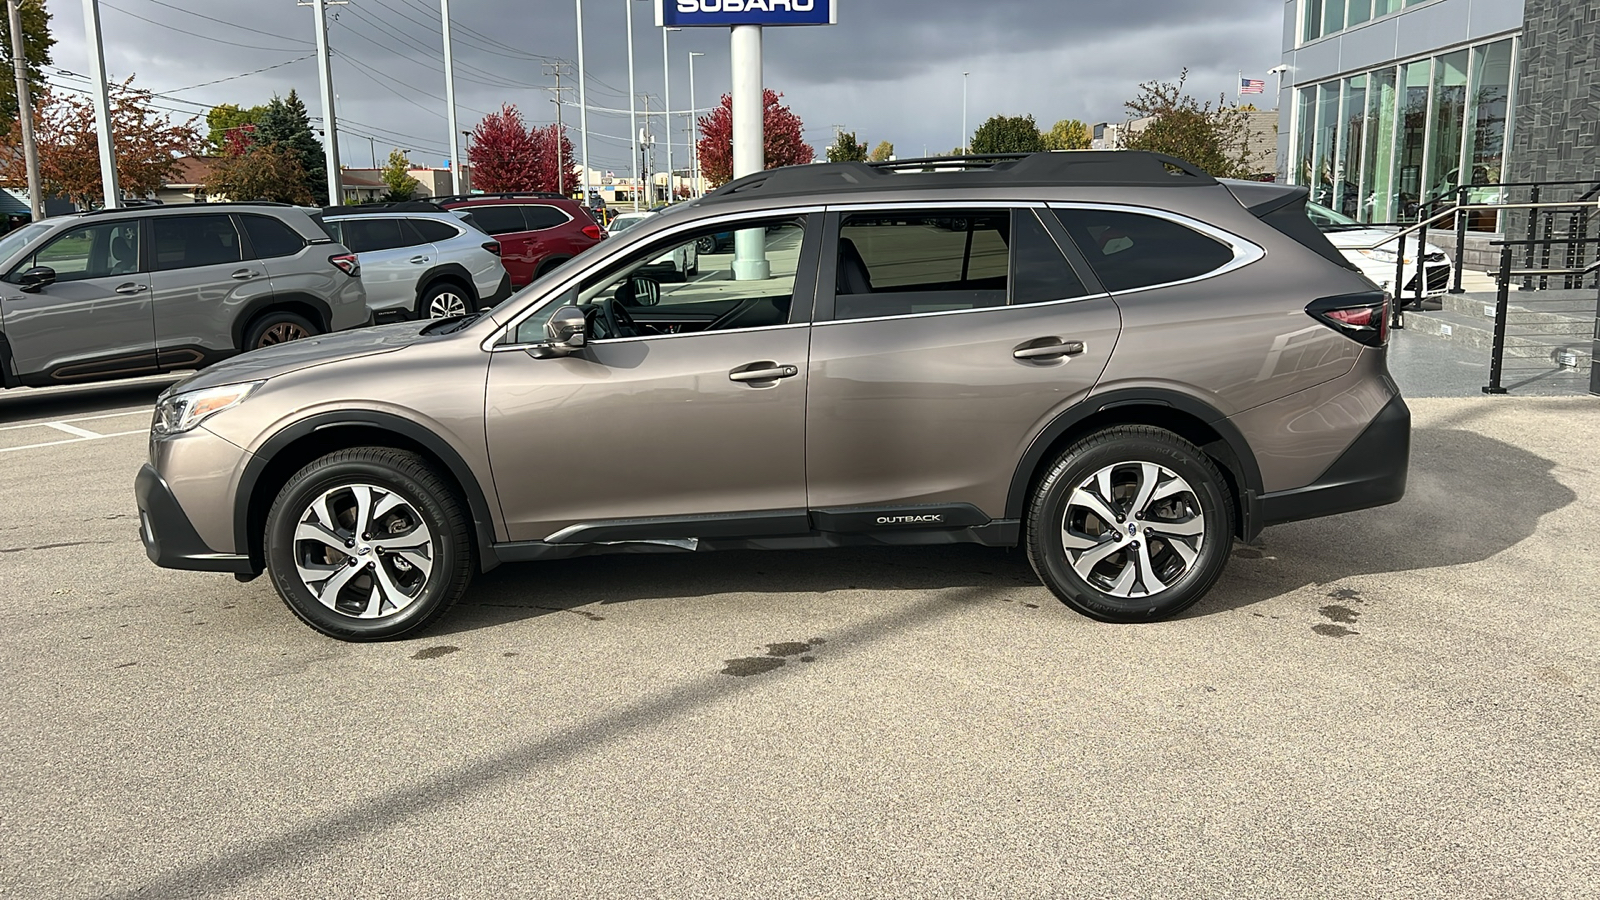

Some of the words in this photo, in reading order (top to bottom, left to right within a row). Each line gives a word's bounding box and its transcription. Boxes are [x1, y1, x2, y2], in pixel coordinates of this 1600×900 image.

[677, 0, 814, 12] SUBARU
[404, 480, 446, 528] YOKOHAMA
[877, 514, 941, 524] OUTBACK
